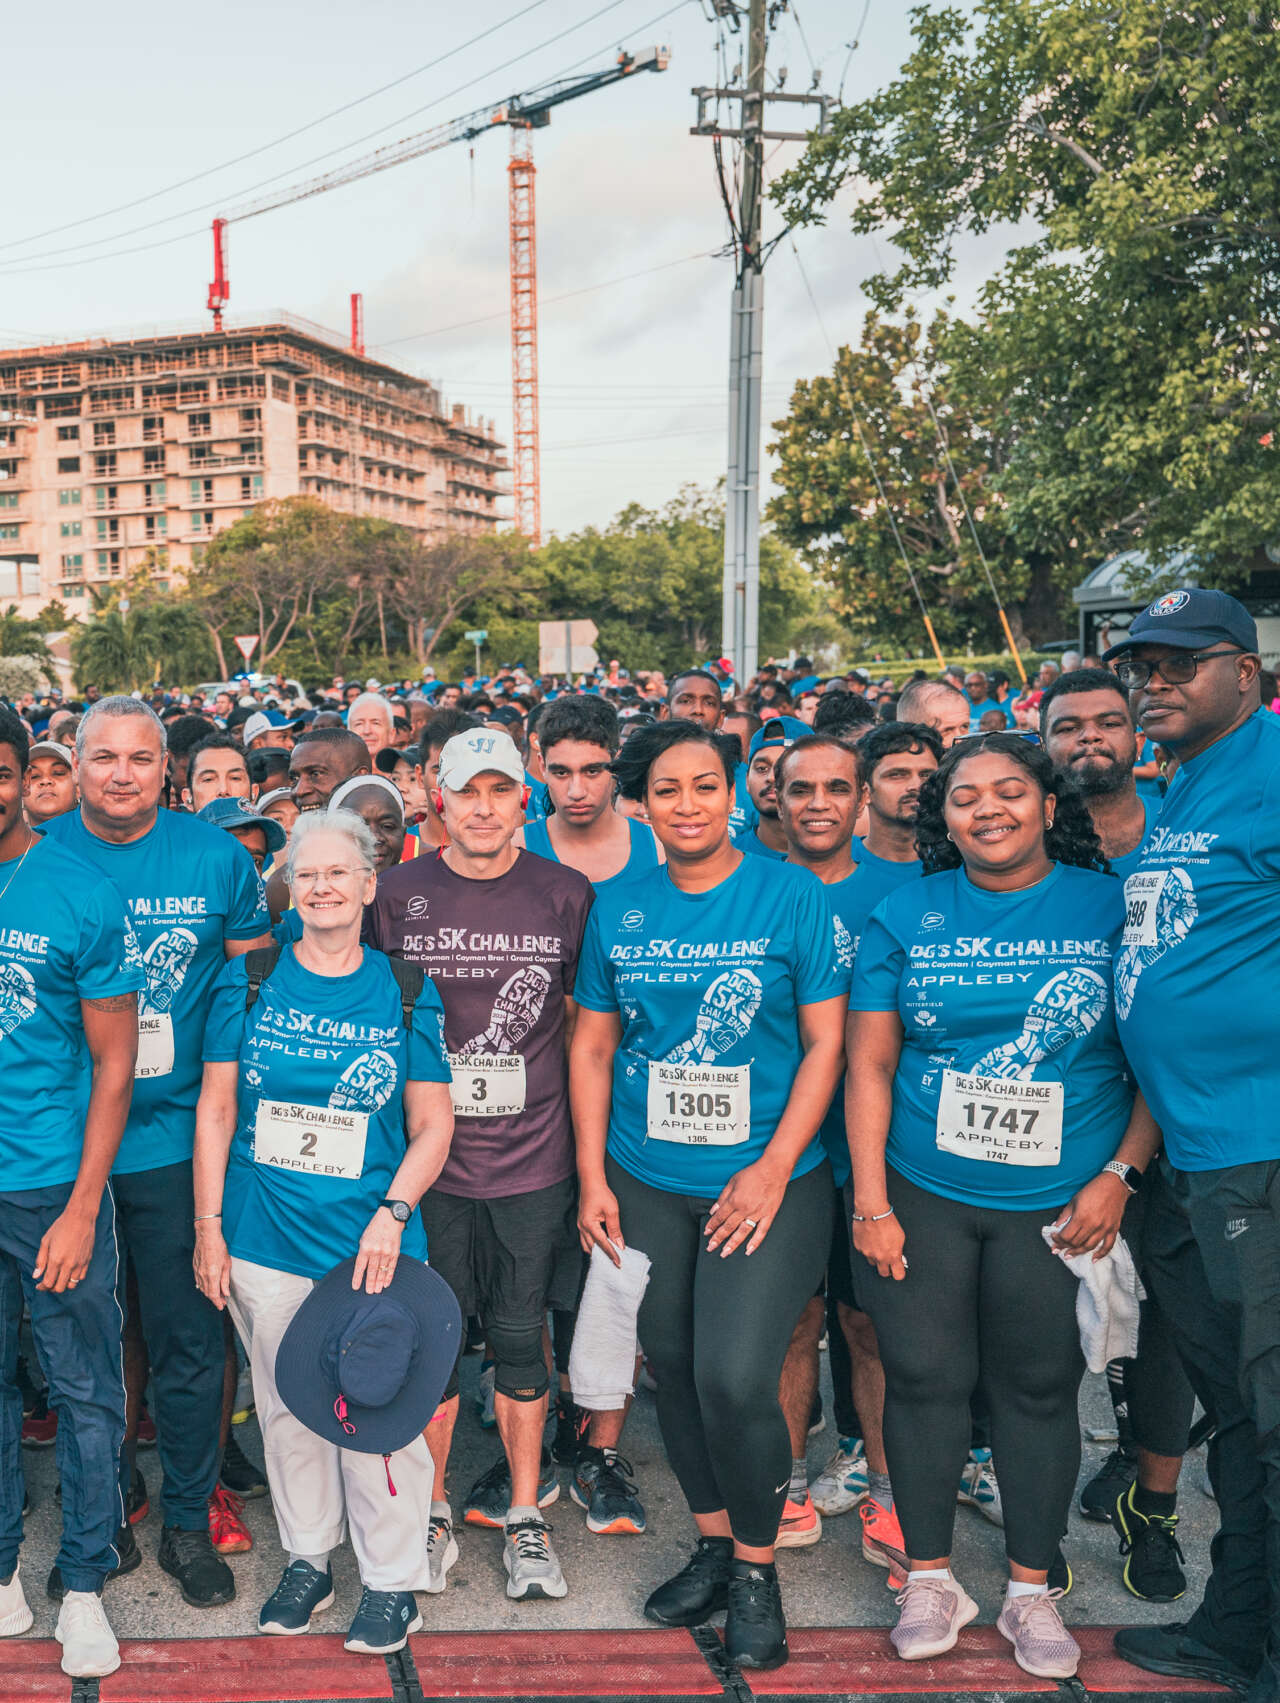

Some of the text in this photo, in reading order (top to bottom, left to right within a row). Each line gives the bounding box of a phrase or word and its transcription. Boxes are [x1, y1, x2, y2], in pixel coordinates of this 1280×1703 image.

[153, 917, 177, 925] Grand
[178, 918, 206, 927] Cayman
[437, 927, 467, 951] 5K
[470, 933, 562, 954] CHALLENGE
[645, 938, 677, 958] 5K
[954, 937, 992, 957] 5K
[994, 939, 1112, 958] CHALLENGE
[15, 953, 46, 965] Cayman
[152, 945, 184, 973] 5K
[420, 954, 450, 962] Cayman
[456, 954, 486, 962] Cayman
[534, 955, 561, 963] Cayman
[931, 960, 969, 969] Cayman
[976, 960, 1016, 969] Cayman
[1048, 957, 1077, 965] Grand
[907, 972, 1033, 988] APPLEBY
[507, 980, 538, 1010] 5K
[712, 985, 746, 1016] 5K
[1047, 983, 1089, 1016] 5K
[286, 1008, 316, 1033] 5K
[494, 998, 537, 1028] CHALLENGE
[699, 1003, 749, 1038] CHALLENGE
[1027, 1004, 1087, 1039] CHALLENGE
[247, 1036, 343, 1061] APPLEBY
[301, 1034, 330, 1046] Cayman
[473, 1057, 520, 1067] CHALLENGE
[991, 1056, 1022, 1080] 10
[350, 1065, 384, 1097] 5K
[689, 1073, 739, 1083] CHALLENGE
[921, 1074, 934, 1087] EY
[975, 1077, 993, 1092] 5K
[993, 1083, 1051, 1098] CHALLENGE
[471, 1078, 487, 1101] 3
[454, 1104, 518, 1114] PPLEBY
[665, 1091, 732, 1117] 1305
[306, 1111, 355, 1127] CHALLENGE
[661, 1119, 738, 1131] APPLEBY
[962, 1102, 1039, 1135] 1747
[299, 1132, 318, 1158] 2
[687, 1135, 708, 1143] 1305
[955, 1131, 1044, 1150] APPLEBY
[269, 1156, 346, 1175] APPLEBY
[986, 1150, 1009, 1161] 1747
